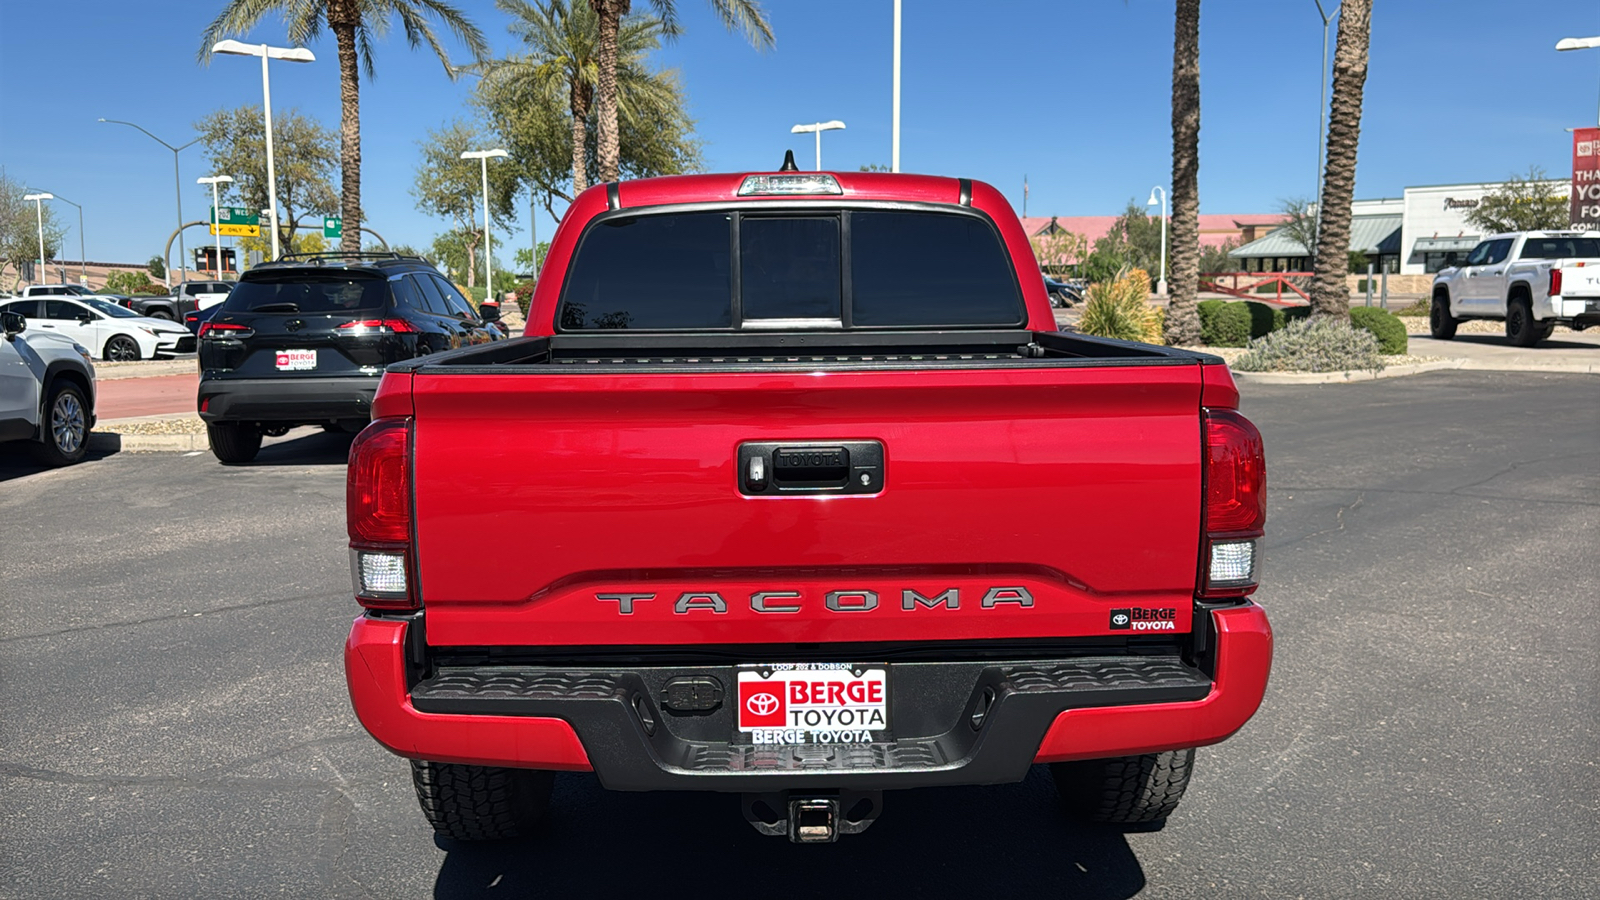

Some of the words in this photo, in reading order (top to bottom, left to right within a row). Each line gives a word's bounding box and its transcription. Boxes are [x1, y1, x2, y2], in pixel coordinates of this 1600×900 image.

[290, 353, 314, 361] BERGE
[779, 452, 843, 467] TOYOTA
[595, 587, 1035, 615] TACOMA
[1131, 607, 1176, 620] BERGE
[1131, 621, 1175, 631] TOYOTA
[771, 663, 794, 671] LOOP
[796, 663, 809, 671] 202
[810, 663, 817, 671] &
[818, 662, 853, 670] DOBSON
[789, 680, 883, 706] BERGE
[789, 708, 885, 727] TOYOTA
[752, 729, 806, 745] BERGE
[810, 730, 873, 744] TOYOTA
